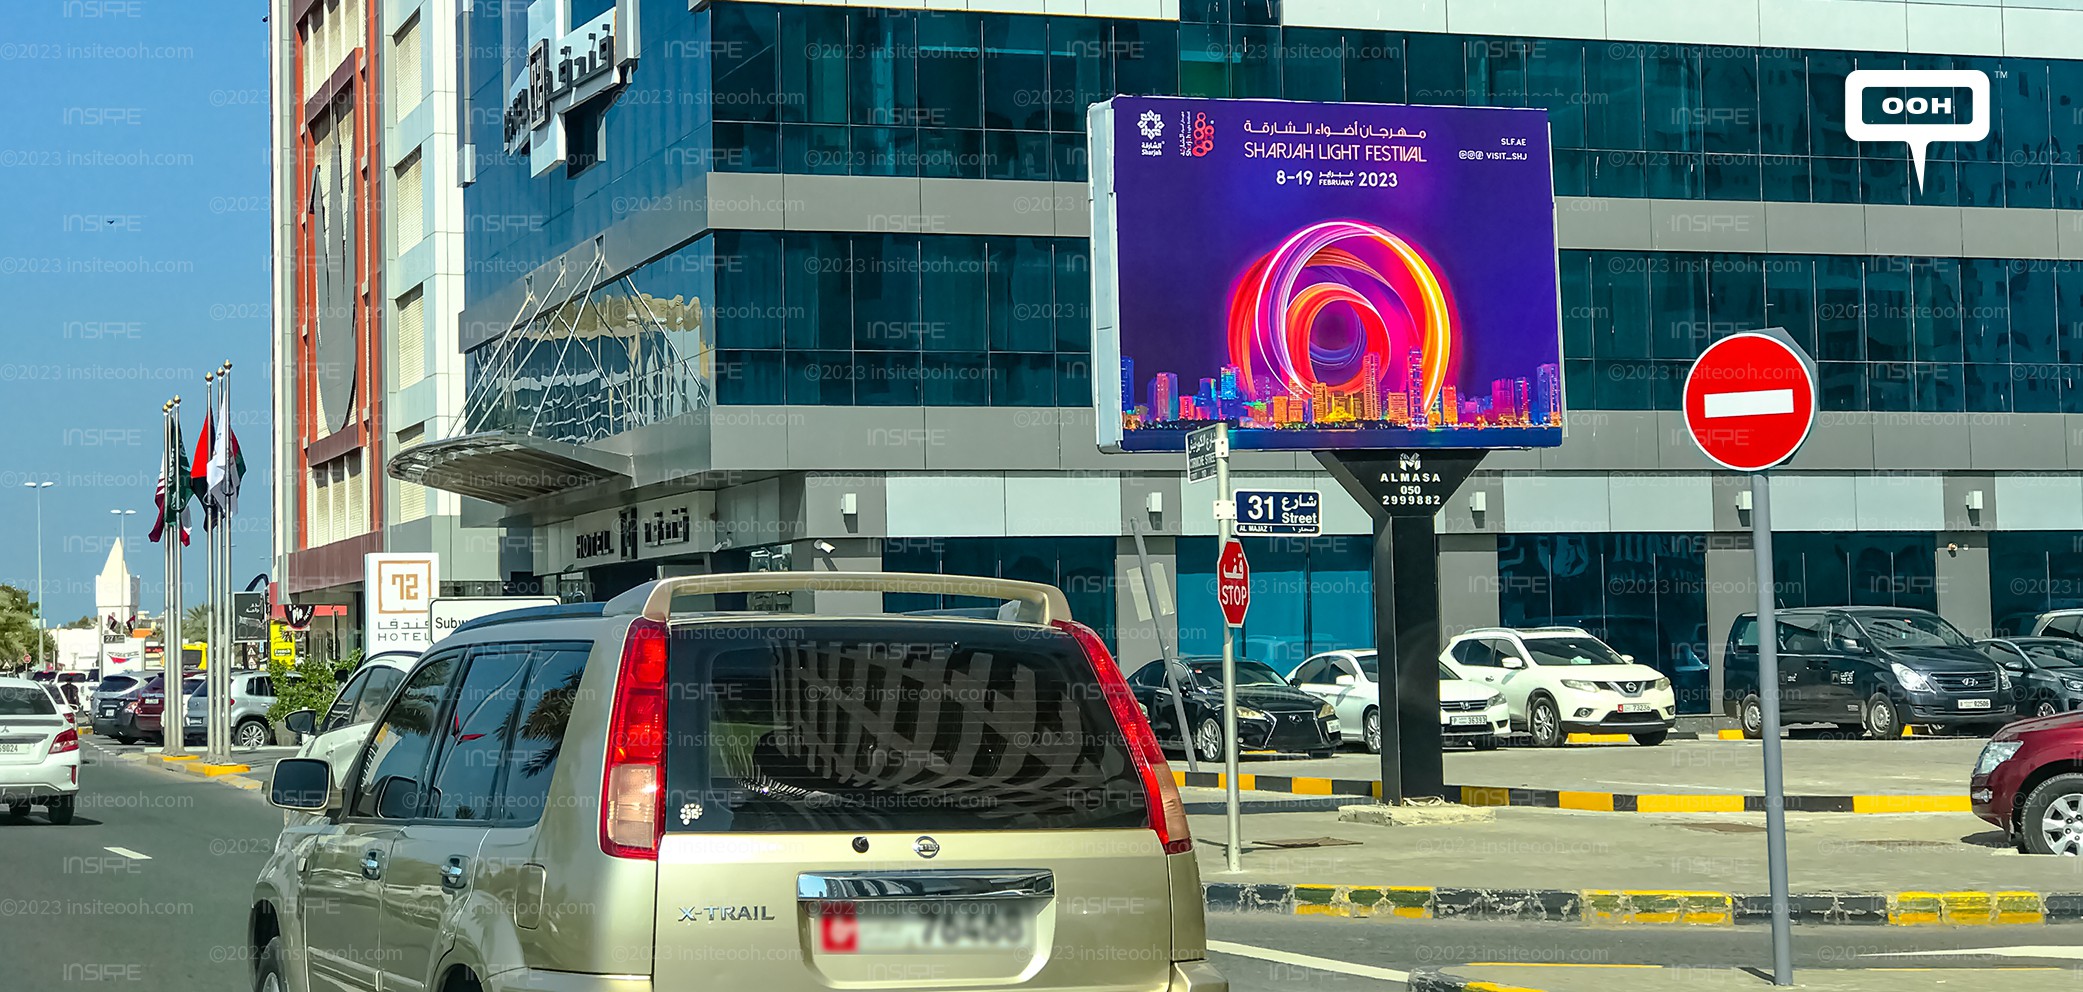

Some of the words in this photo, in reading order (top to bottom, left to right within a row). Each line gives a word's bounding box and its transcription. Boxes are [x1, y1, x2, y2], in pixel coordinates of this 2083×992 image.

[1243, 119, 1312, 136] الشارقة
[1315, 120, 1358, 138] أضواء
[1359, 124, 1427, 139] مهرجان
[1244, 141, 1314, 160] SHARJAH
[1319, 144, 1361, 161] LIGHT
[1366, 145, 1428, 163] FESTIVAL
[1486, 151, 1528, 161] VISIT_SHJ
[1318, 178, 1355, 187] FEBRUARY
[1358, 171, 1399, 188] 2023
[1379, 472, 1441, 483] ALMASA
[1400, 485, 1421, 495] 050
[1247, 494, 1274, 520] 31
[1281, 493, 1317, 511] شارع
[1382, 495, 1441, 505] 2999882
[1281, 512, 1317, 524] Street
[1223, 552, 1244, 579] قف
[391, 573, 418, 600] 72
[1221, 584, 1248, 606] STOP
[677, 905, 776, 922] X-TRAIL
